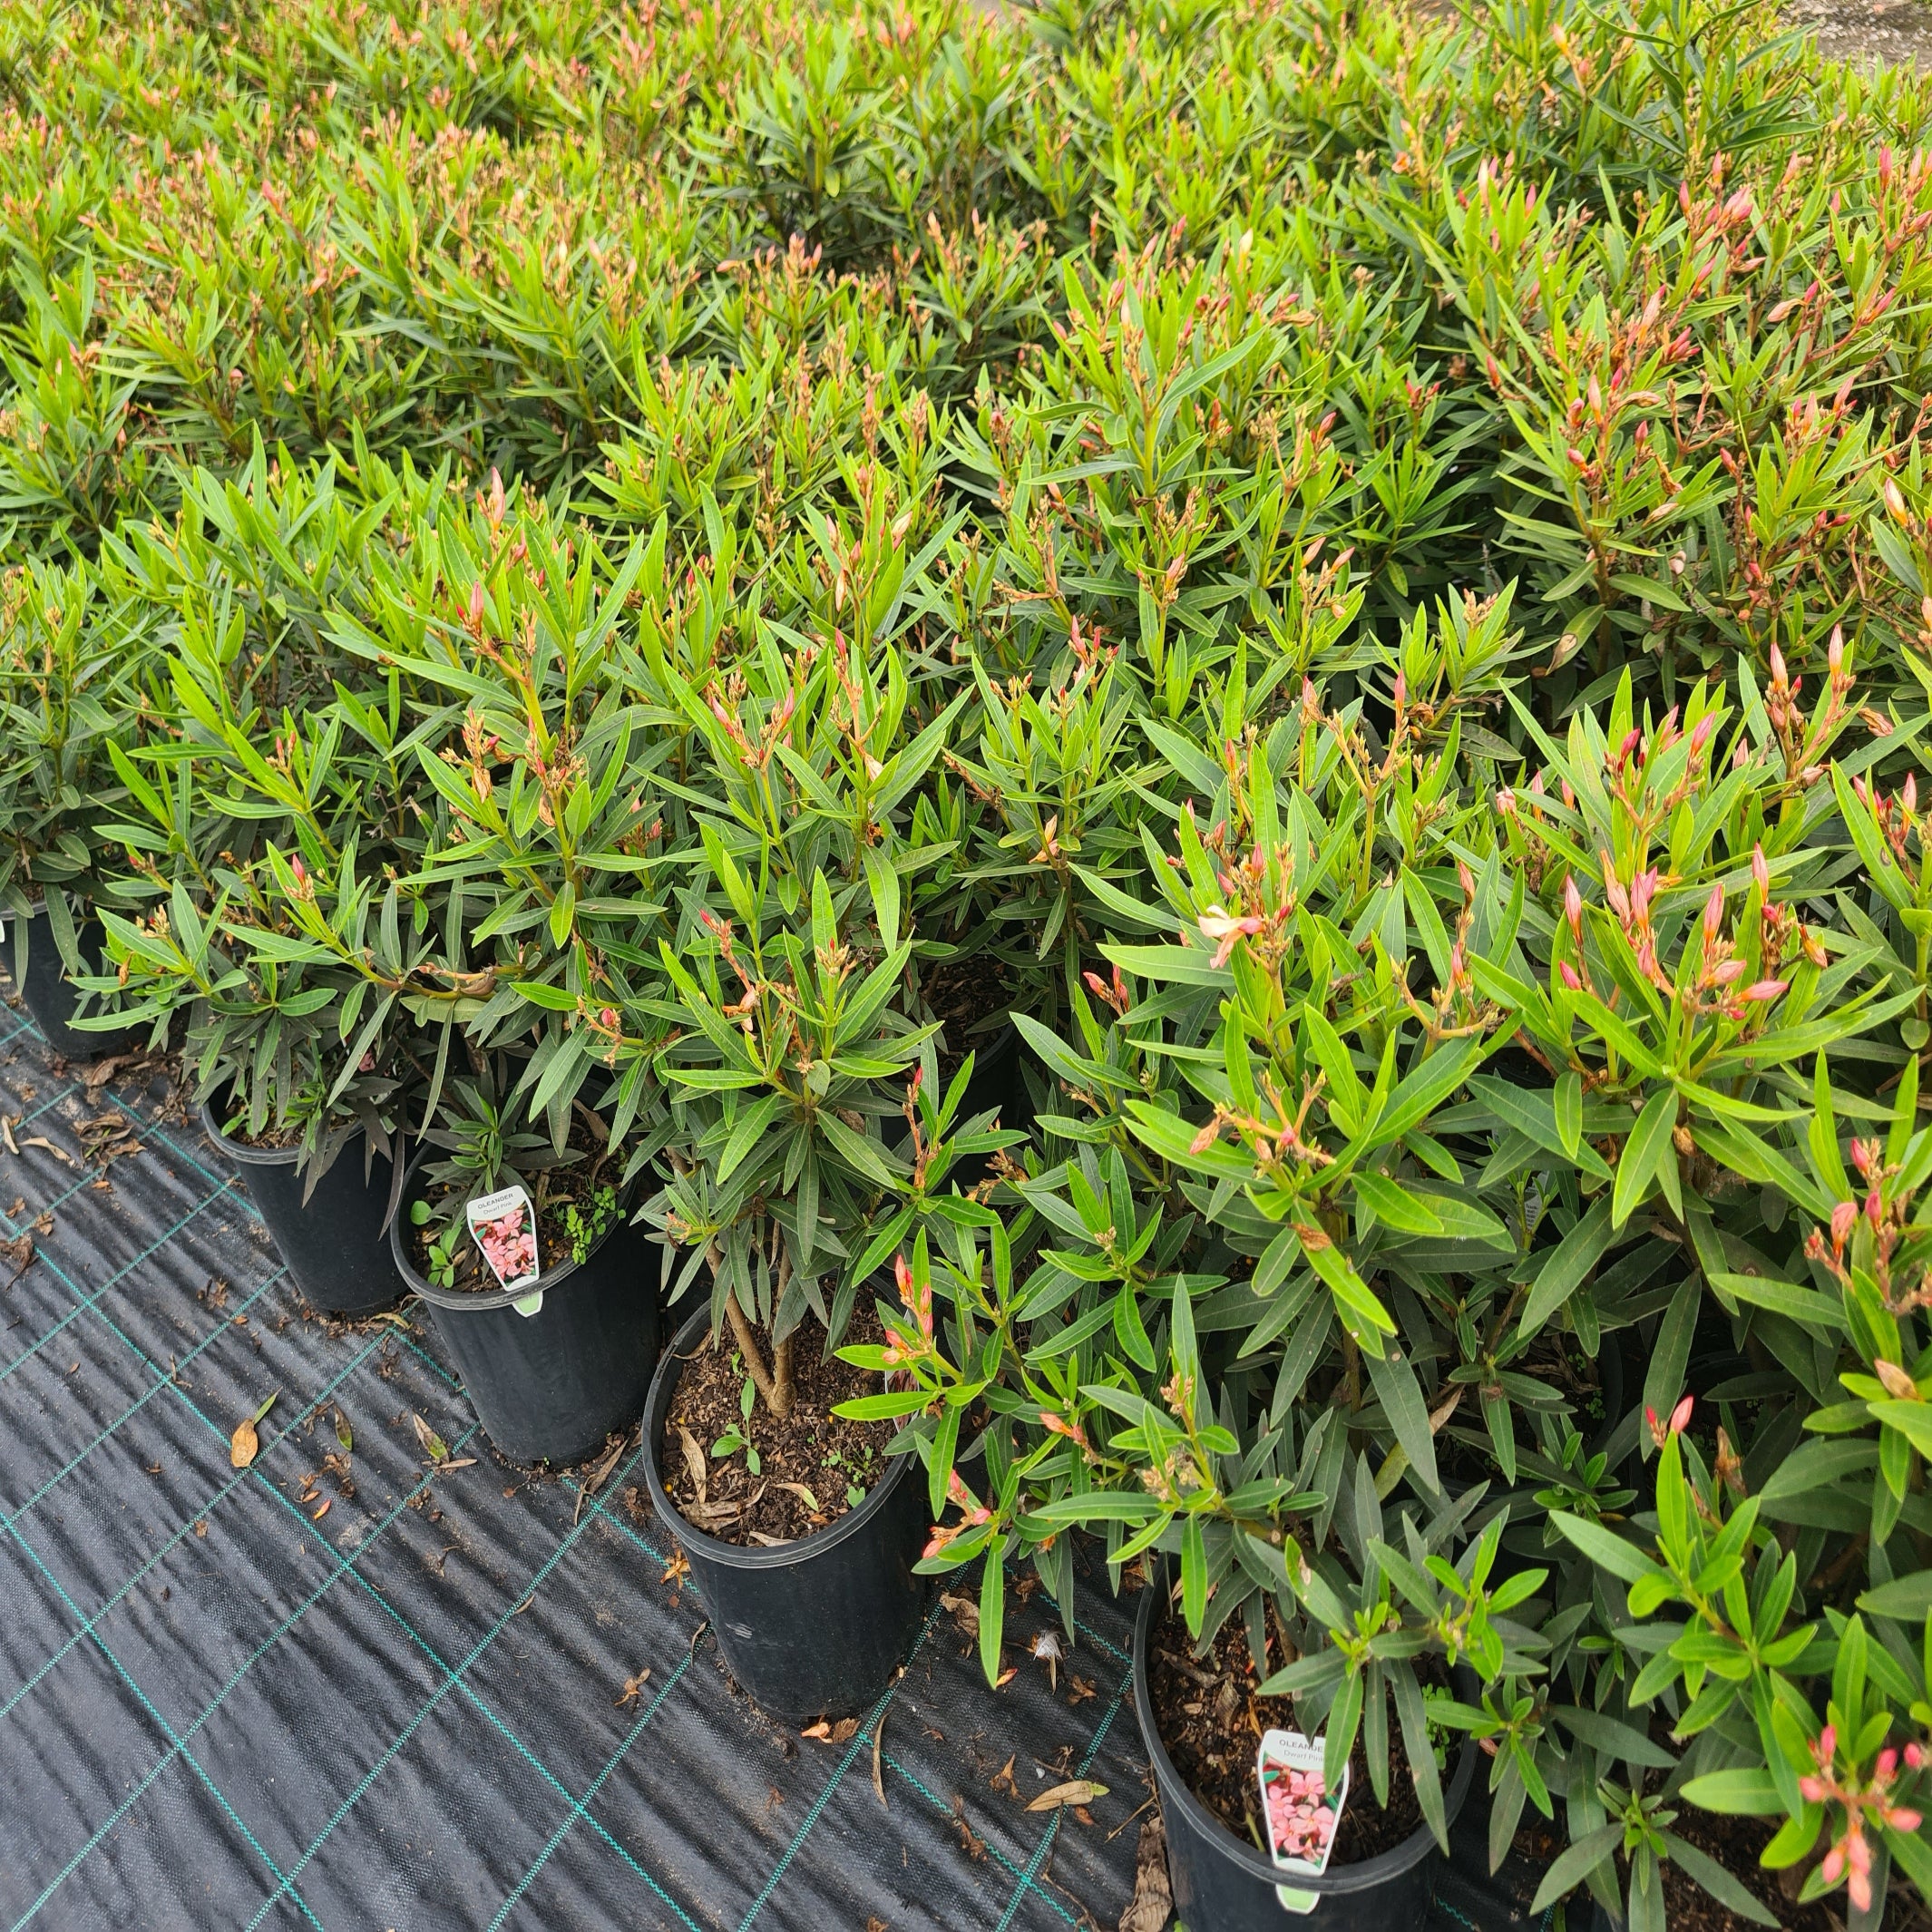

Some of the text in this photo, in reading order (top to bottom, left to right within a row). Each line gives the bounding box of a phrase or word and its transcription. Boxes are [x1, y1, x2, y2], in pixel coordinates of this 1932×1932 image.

[477, 1193, 513, 1209] OLEANDER
[483, 1205, 500, 1215] Dwarf
[1279, 1739, 1323, 1752] OLEANDE
[1283, 1750, 1306, 1760] Dwarf
